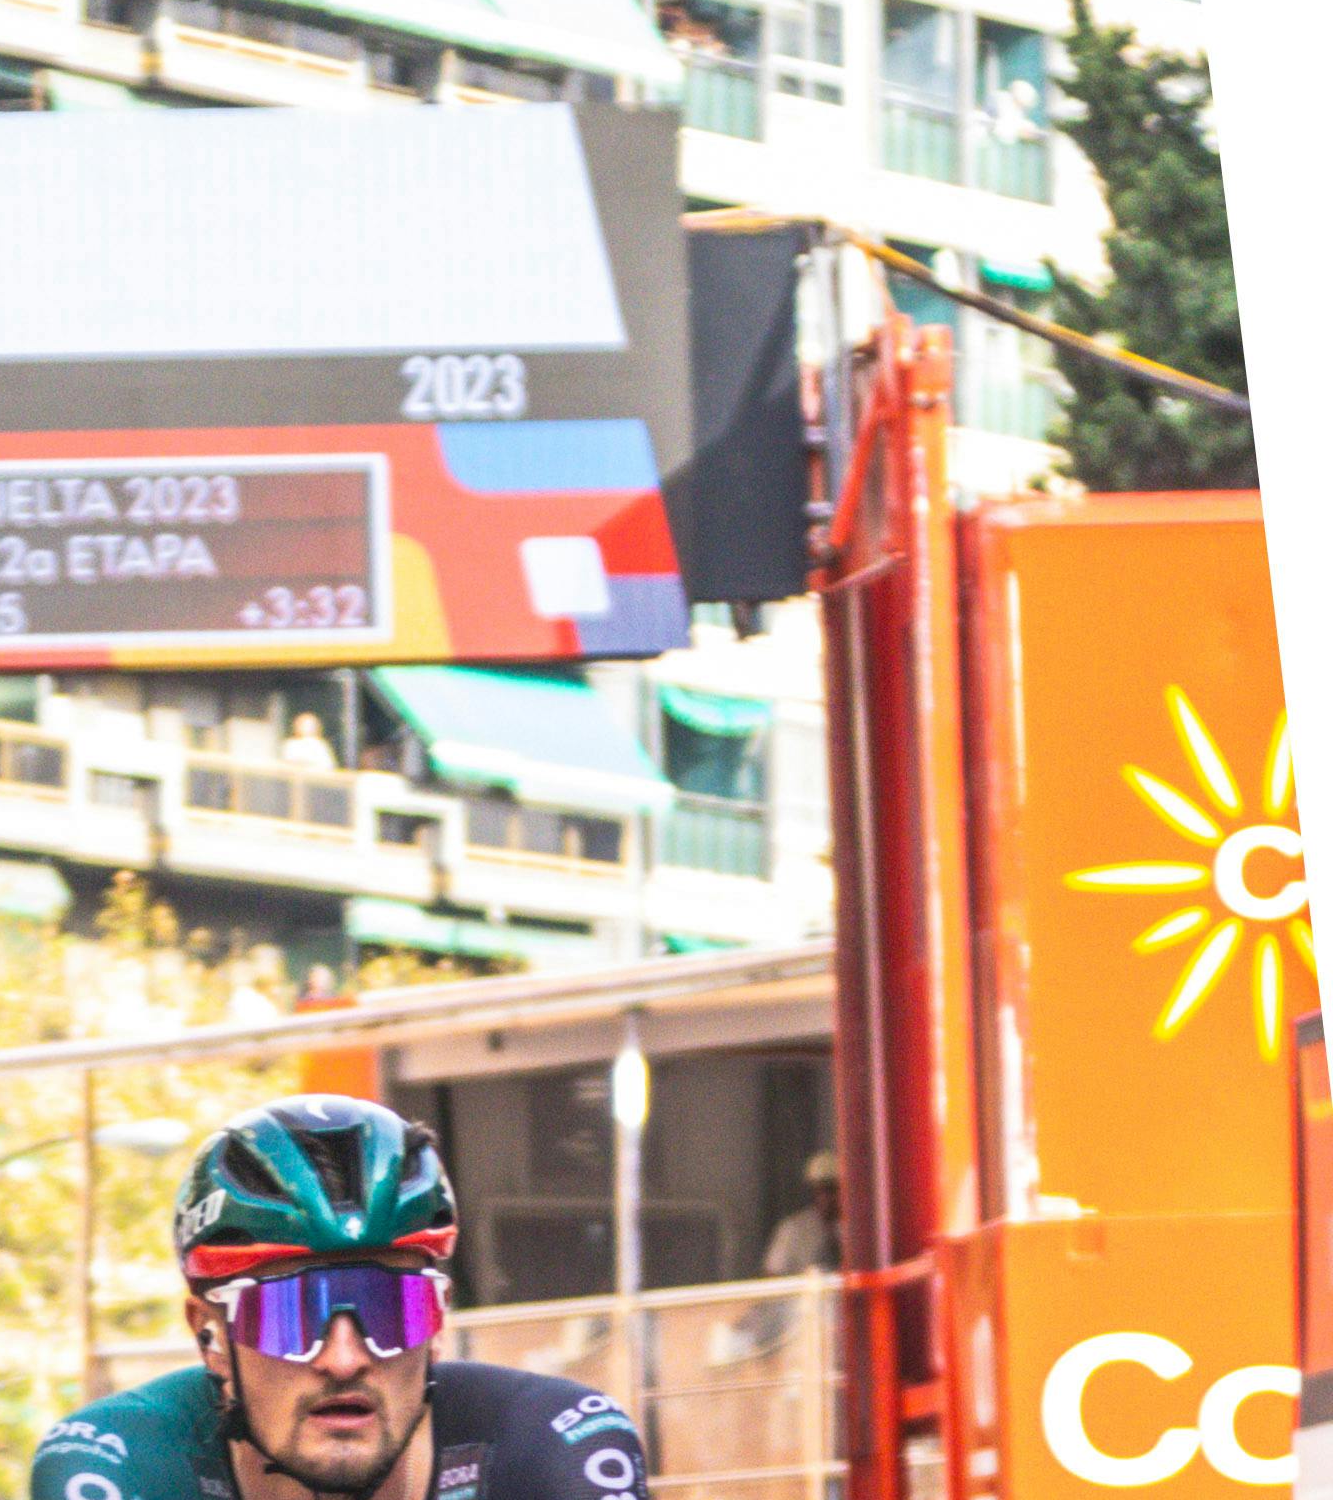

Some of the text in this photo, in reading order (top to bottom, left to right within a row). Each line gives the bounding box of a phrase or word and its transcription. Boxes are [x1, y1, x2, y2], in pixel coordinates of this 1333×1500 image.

[399, 355, 527, 420] 2023
[124, 475, 240, 522] 2023
[67, 534, 218, 578] ETAPA
[238, 585, 368, 629] +3:32
